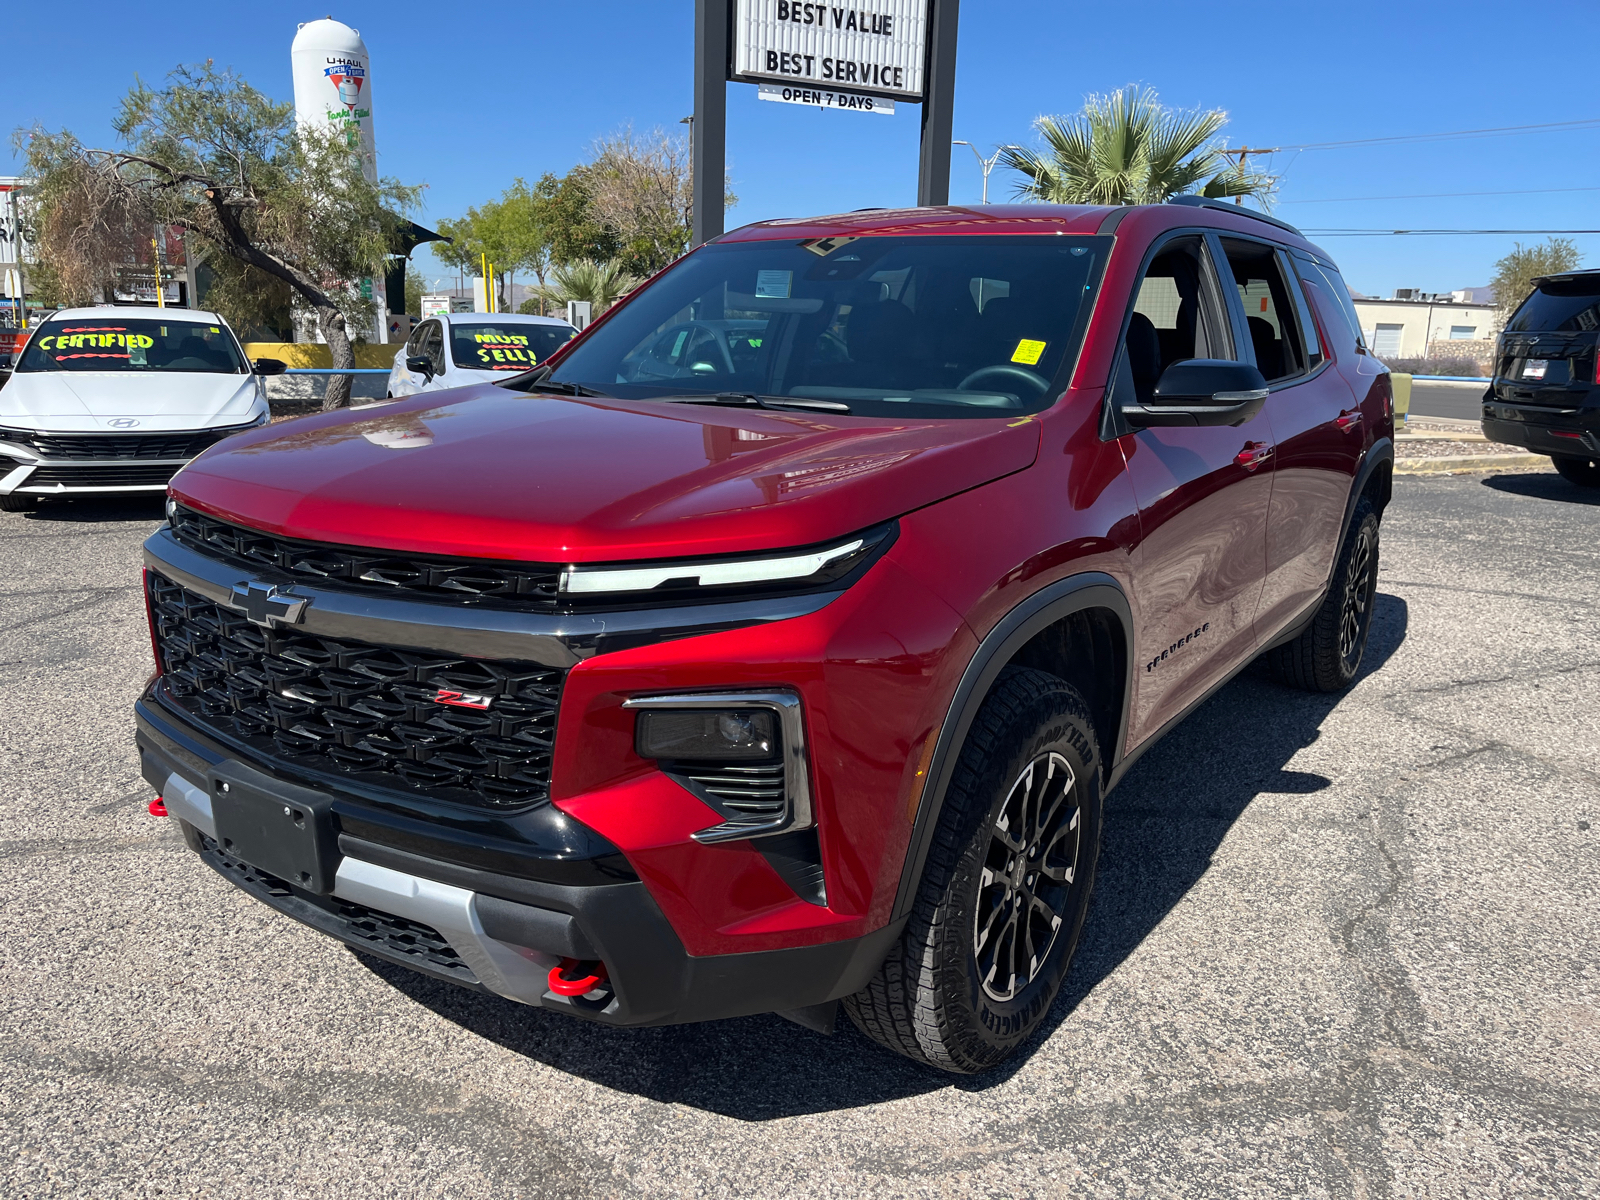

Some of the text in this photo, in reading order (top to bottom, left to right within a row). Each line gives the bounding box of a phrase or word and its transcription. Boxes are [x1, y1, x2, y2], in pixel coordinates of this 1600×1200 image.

[777, 0, 893, 36] BEST VALUE
[326, 57, 363, 69] U-HAUL
[329, 65, 345, 75] OPEN
[766, 50, 903, 88] BEST SERVICE
[781, 87, 874, 111] OPEN 7 DAYS
[38, 333, 154, 350] CERTIFIED
[474, 333, 529, 346] MUST
[476, 348, 537, 366] SELL!
[434, 689, 494, 710] Z71
